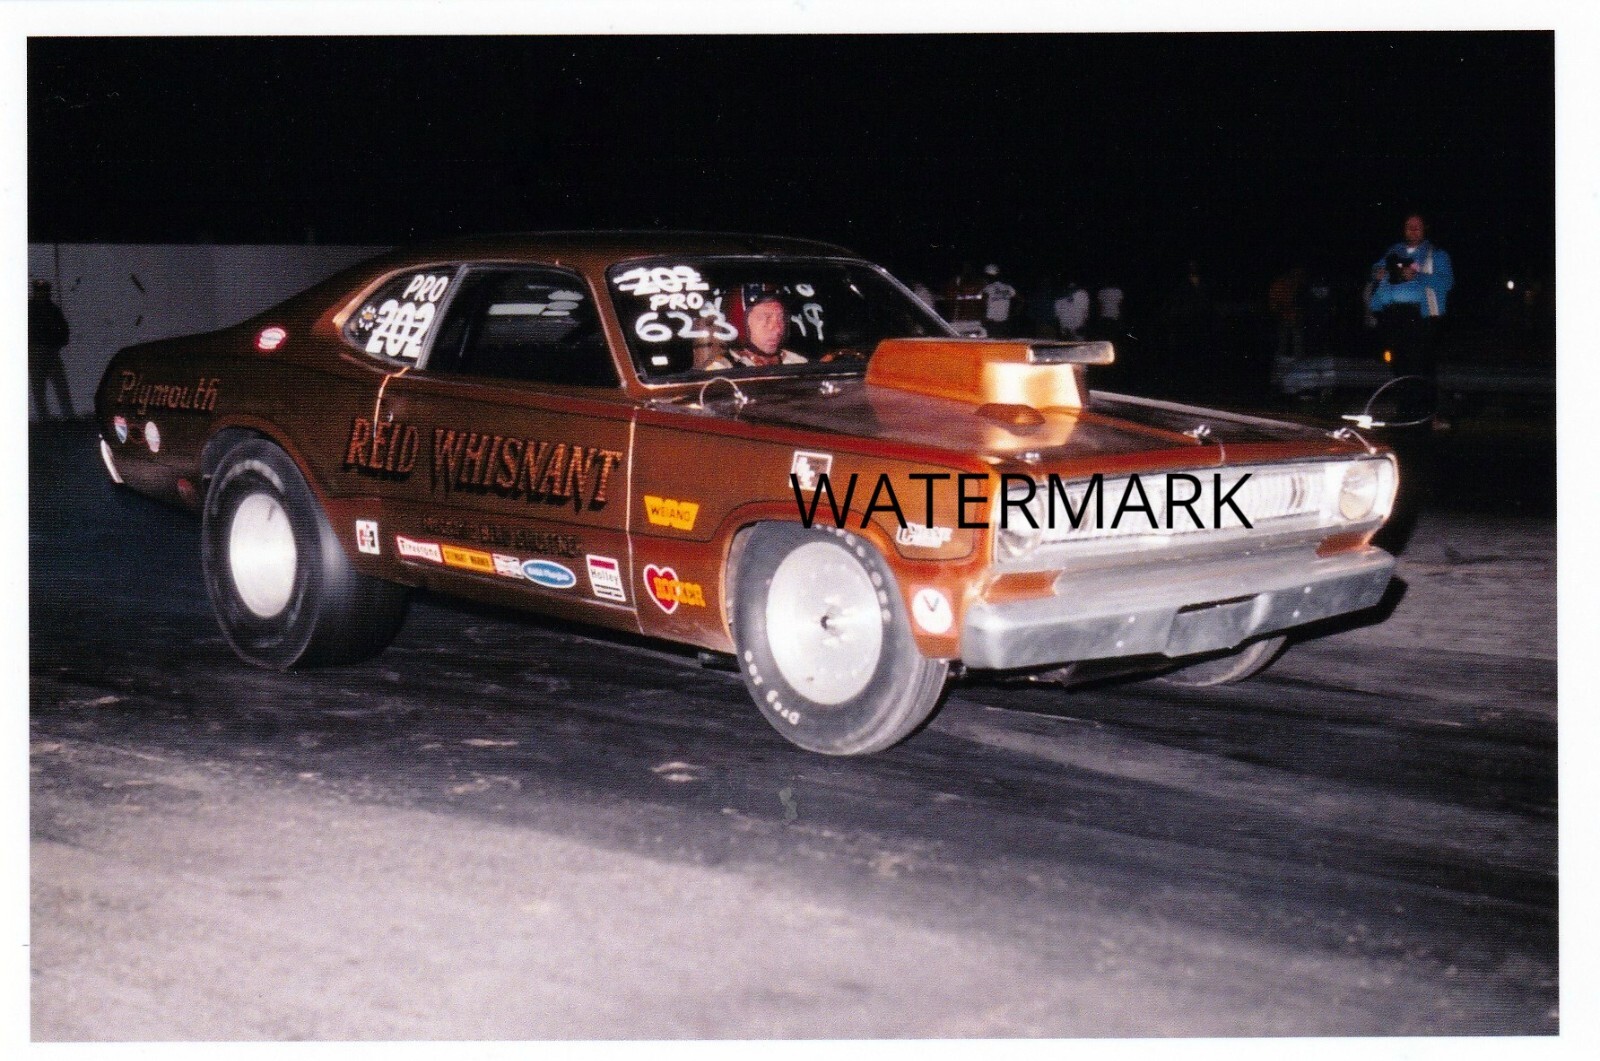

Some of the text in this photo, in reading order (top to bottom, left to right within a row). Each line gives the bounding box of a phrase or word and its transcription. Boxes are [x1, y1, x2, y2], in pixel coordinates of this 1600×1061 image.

[402, 274, 449, 303] PRO
[649, 291, 704, 311] PRO
[635, 309, 739, 342] 623
[115, 369, 221, 416] Plymouth
[345, 416, 624, 503] REID WHISNANT
[590, 569, 619, 587] Holley
